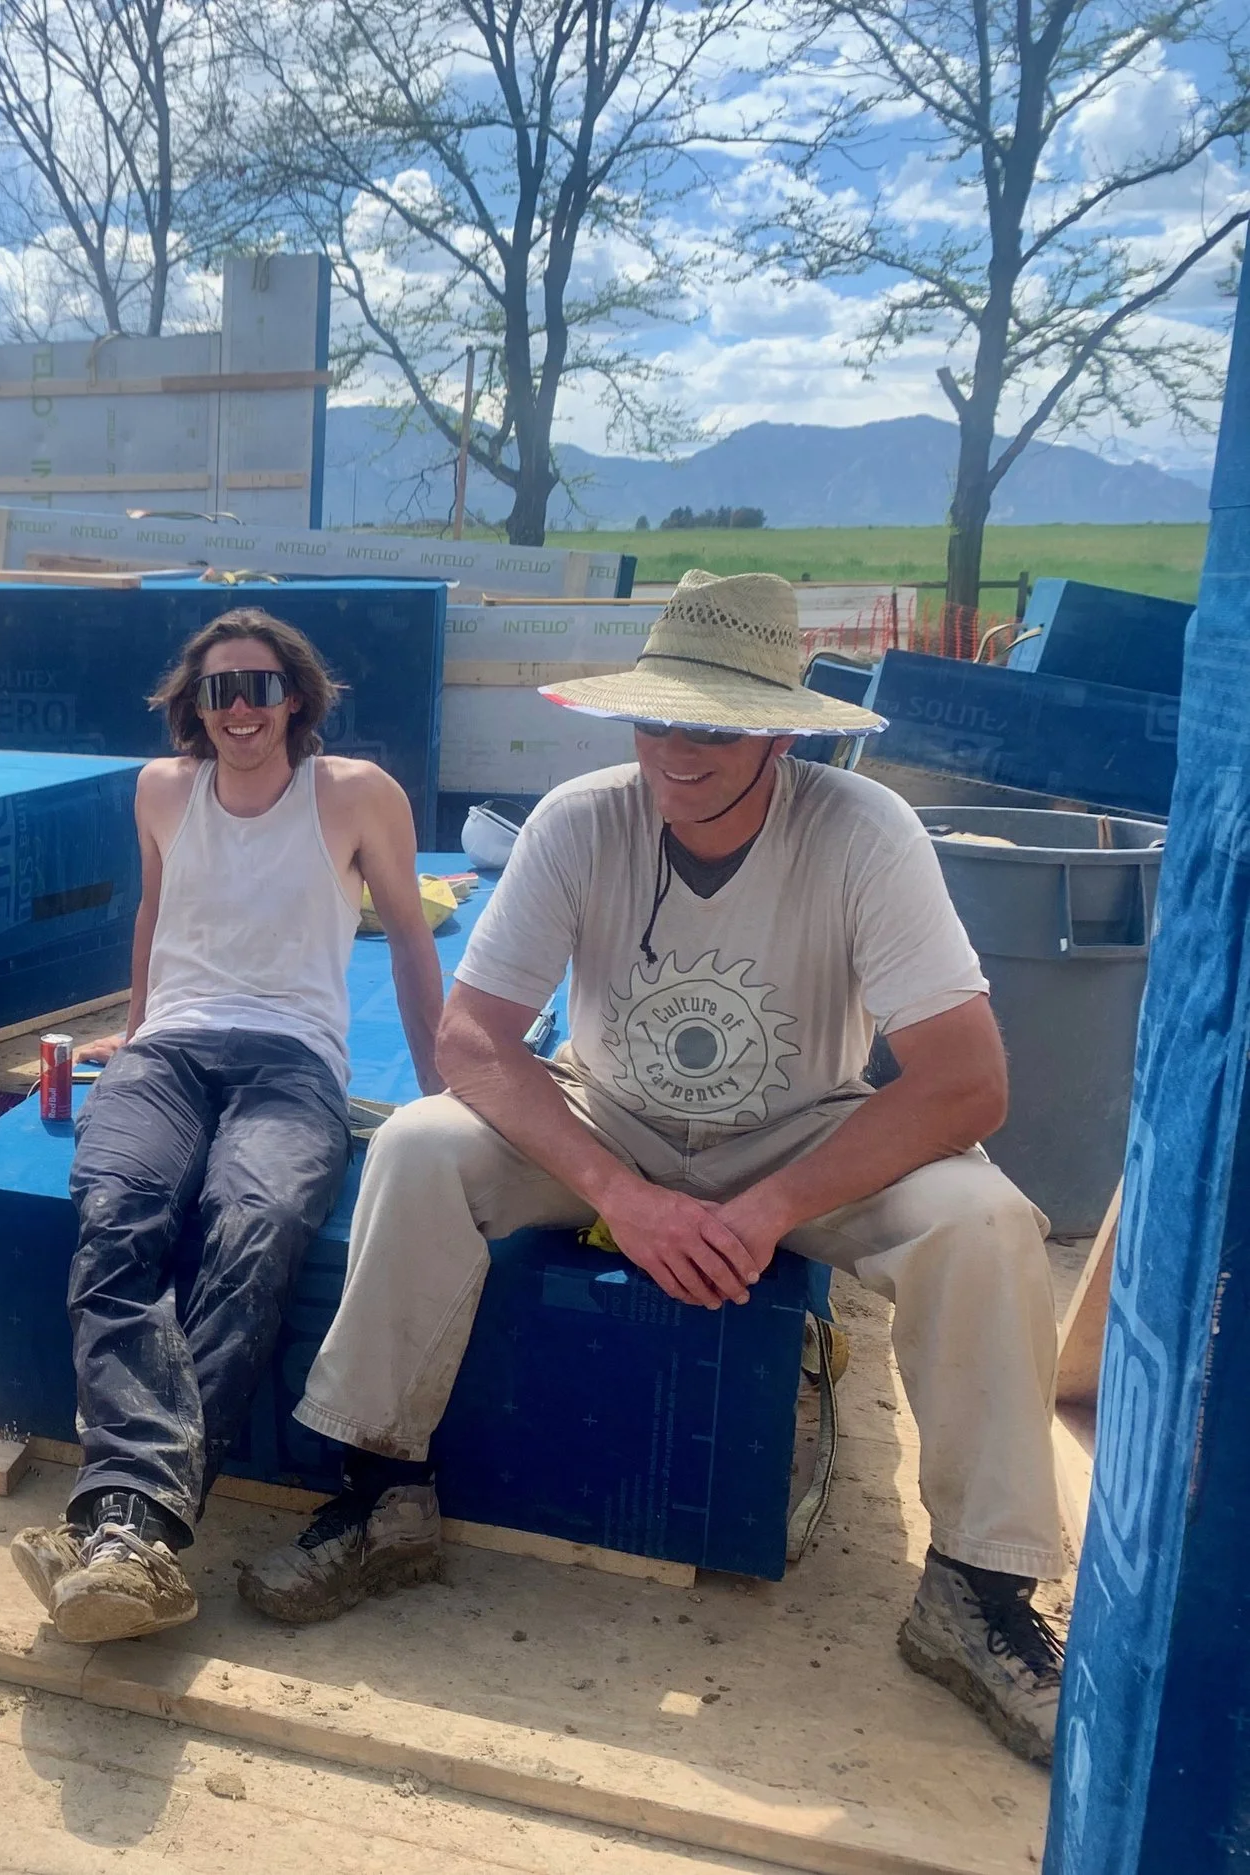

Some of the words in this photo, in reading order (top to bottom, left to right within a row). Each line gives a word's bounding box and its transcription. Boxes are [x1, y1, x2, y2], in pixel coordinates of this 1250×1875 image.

[70, 525, 118, 540] INTELLO
[136, 530, 186, 546] INTELLO
[203, 535, 256, 551] INTELLO
[275, 541, 327, 556] INTELLO
[347, 546, 400, 562] INTELLO
[421, 552, 476, 568] INTELLO
[495, 557, 551, 574] INTELLO
[503, 619, 568, 634] INTELLO
[652, 996, 718, 1024] Culture
[721, 1012, 746, 1032] of
[646, 1062, 741, 1103] Carpentry
[48, 1087, 57, 1103] Bull
[48, 1103, 57, 1119] Red
